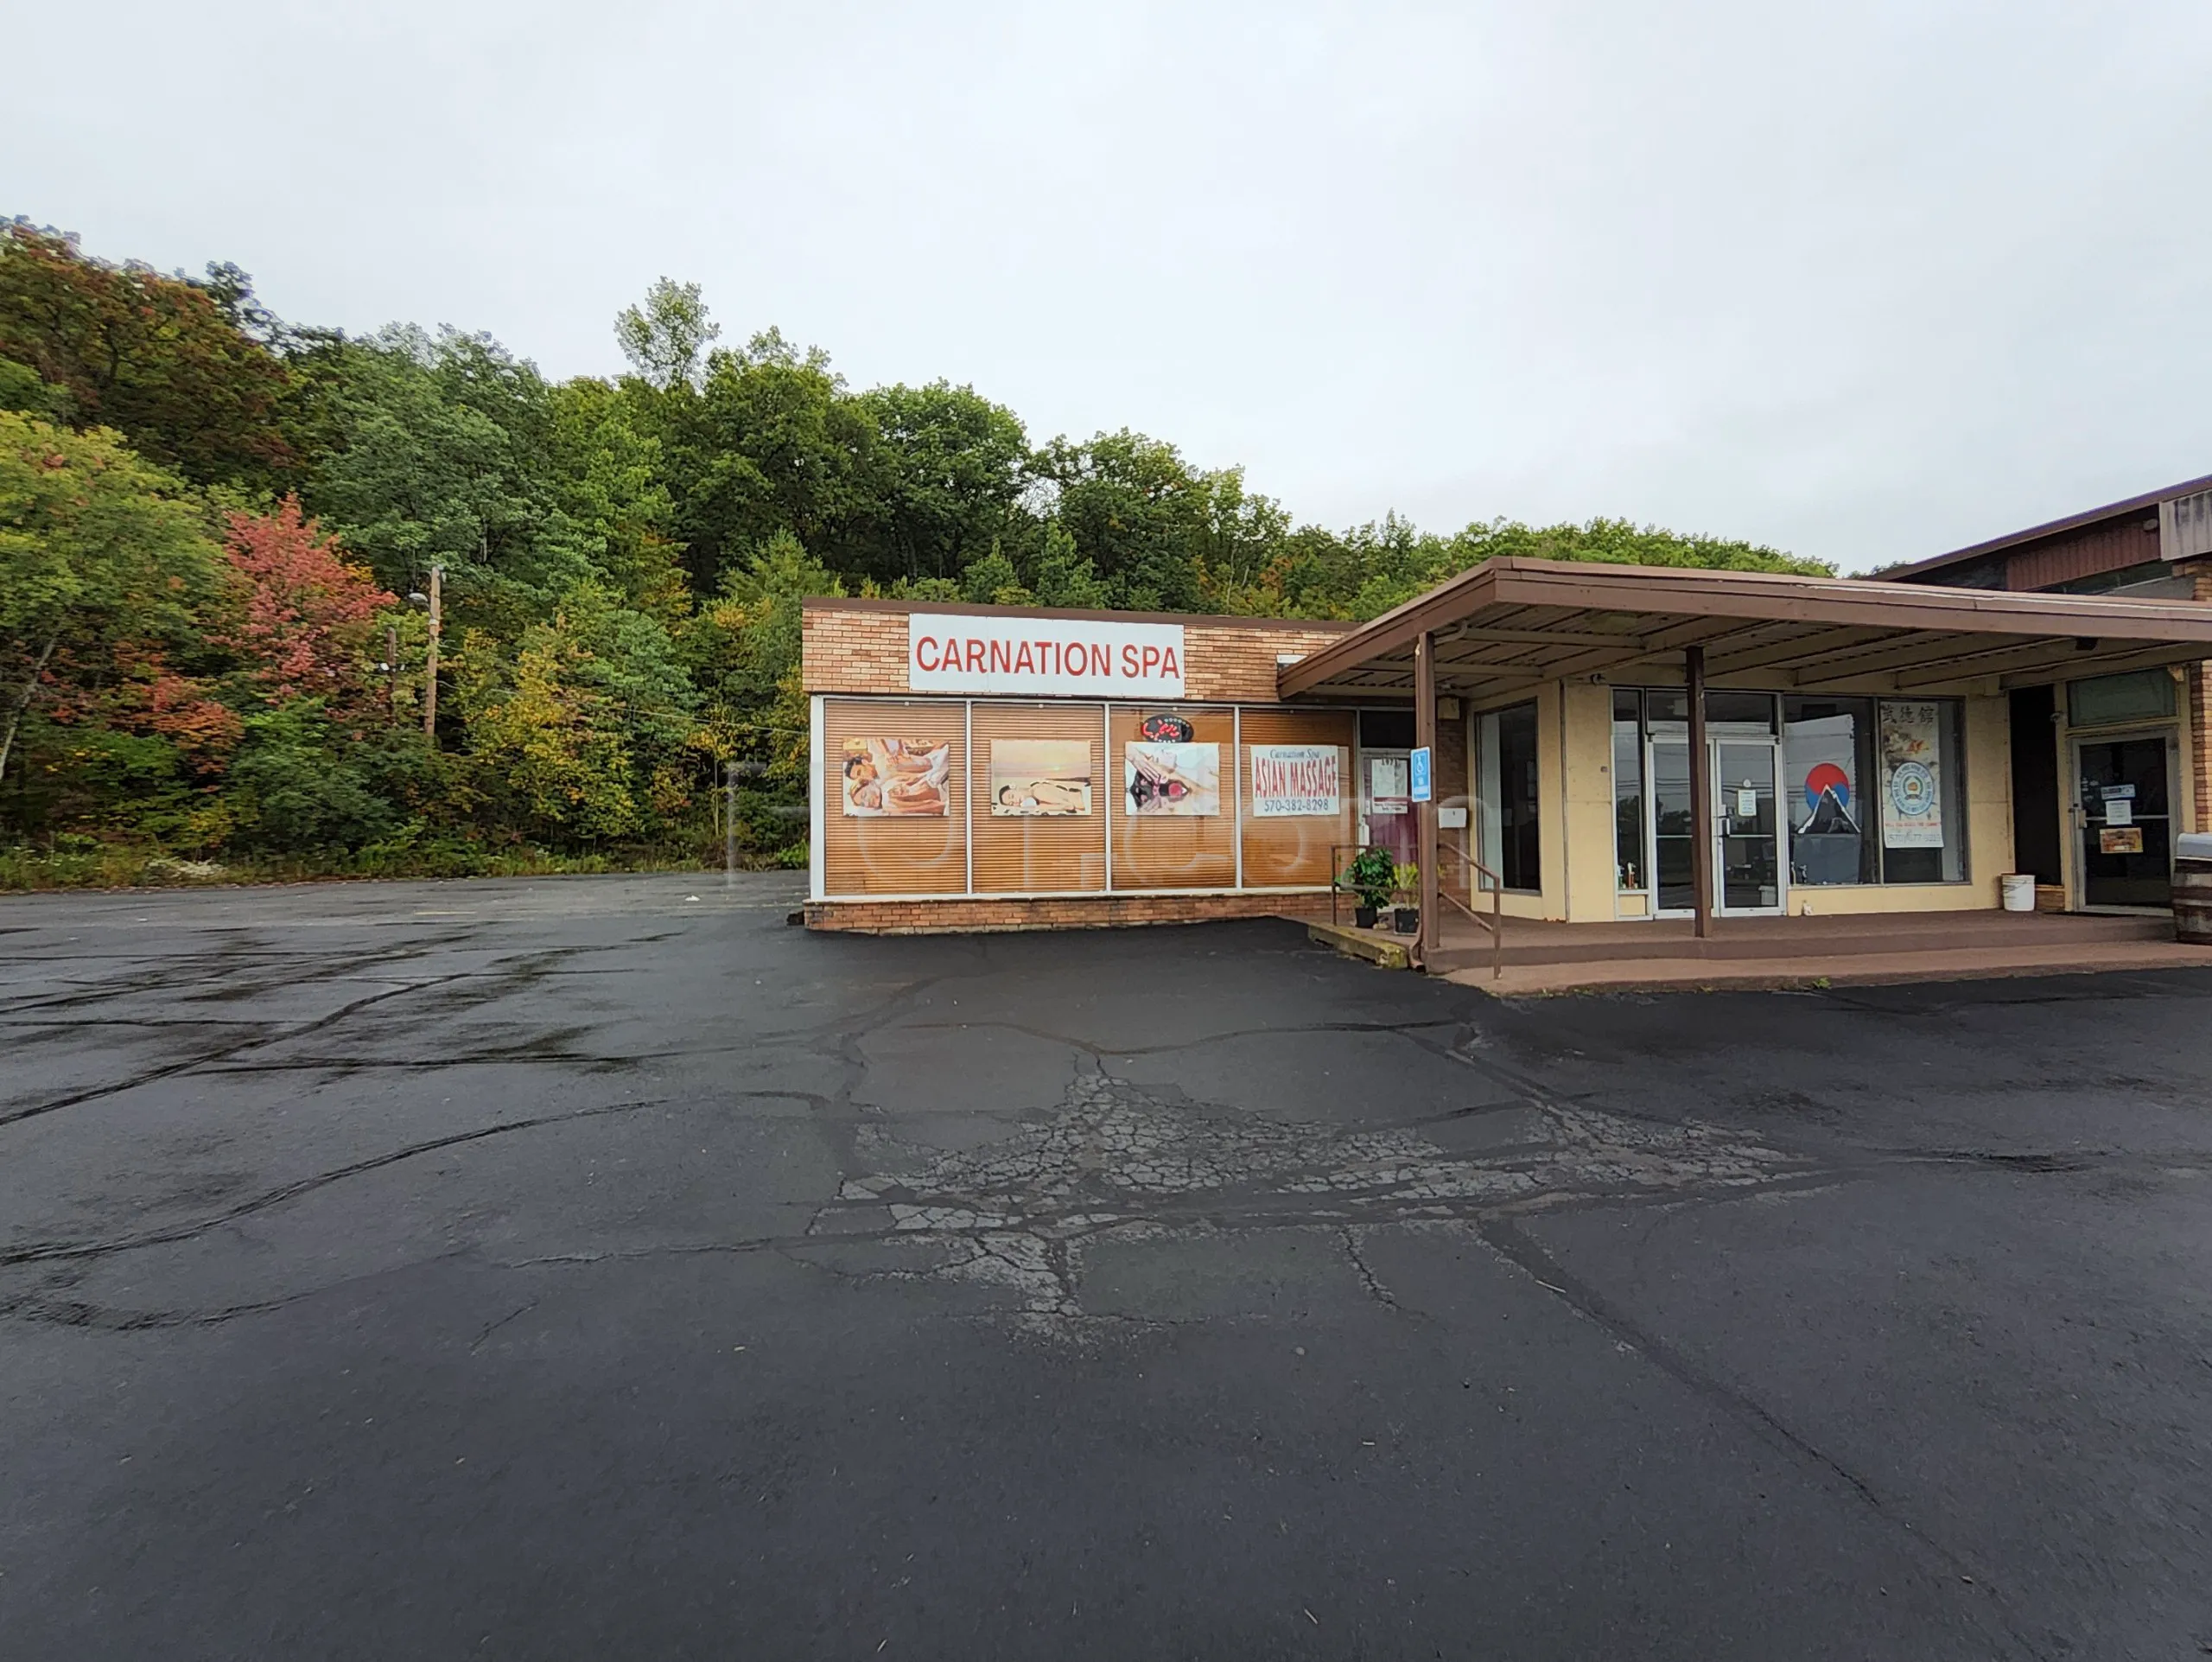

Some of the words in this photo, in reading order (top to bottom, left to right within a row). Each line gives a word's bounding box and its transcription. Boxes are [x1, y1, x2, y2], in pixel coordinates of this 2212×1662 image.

[916, 636, 1111, 677] CARNATION
[1121, 644, 1180, 679] SPA
[1269, 748, 1305, 759] Carnation
[1306, 748, 1320, 760] Spa
[1255, 756, 1287, 799] ASIAN
[1290, 755, 1337, 798] MASSAGE
[1264, 799, 1329, 812] 570-382-8298
